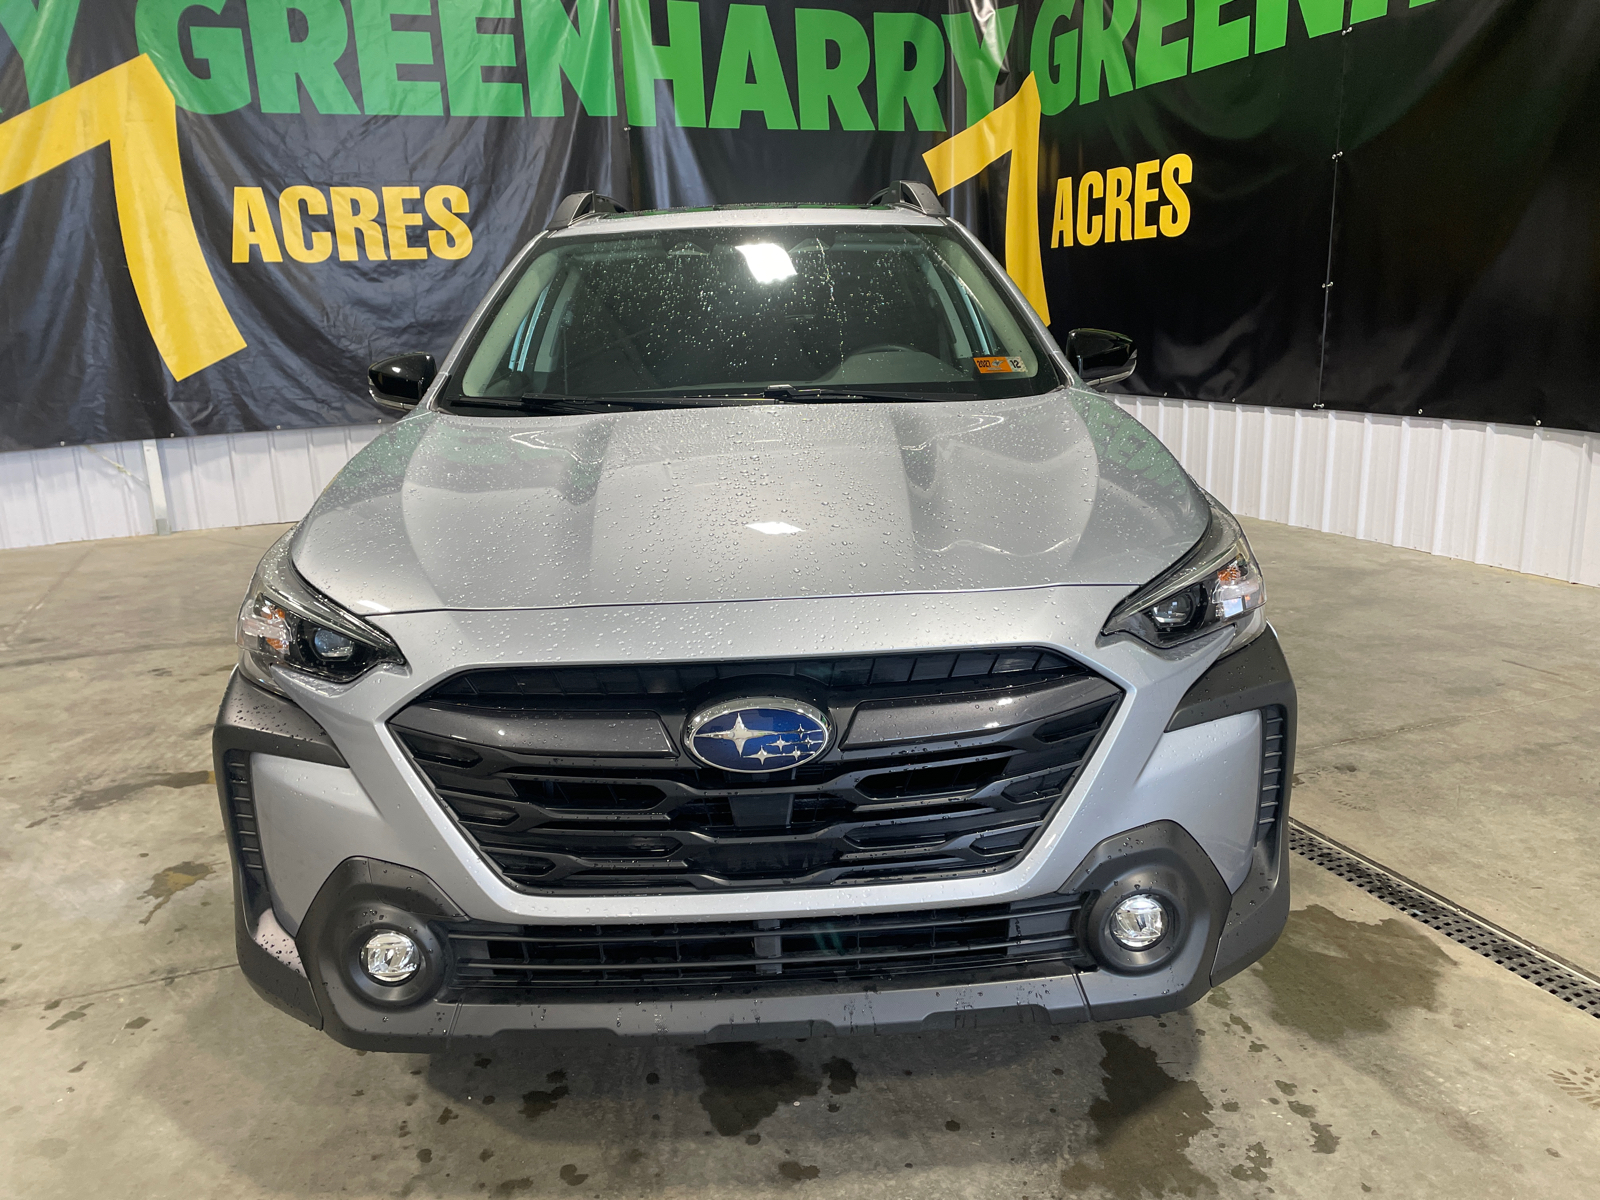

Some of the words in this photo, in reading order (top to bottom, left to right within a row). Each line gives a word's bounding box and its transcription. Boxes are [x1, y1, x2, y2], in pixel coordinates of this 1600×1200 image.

[135, 0, 617, 117] GREEN
[619, 0, 1018, 132] HARRY
[0, 53, 247, 382] 7
[232, 185, 474, 264] ACRES
[922, 71, 1050, 326] 7
[1050, 153, 1194, 249] ACRES
[976, 359, 991, 368] 2027
[1009, 359, 1022, 369] 12
